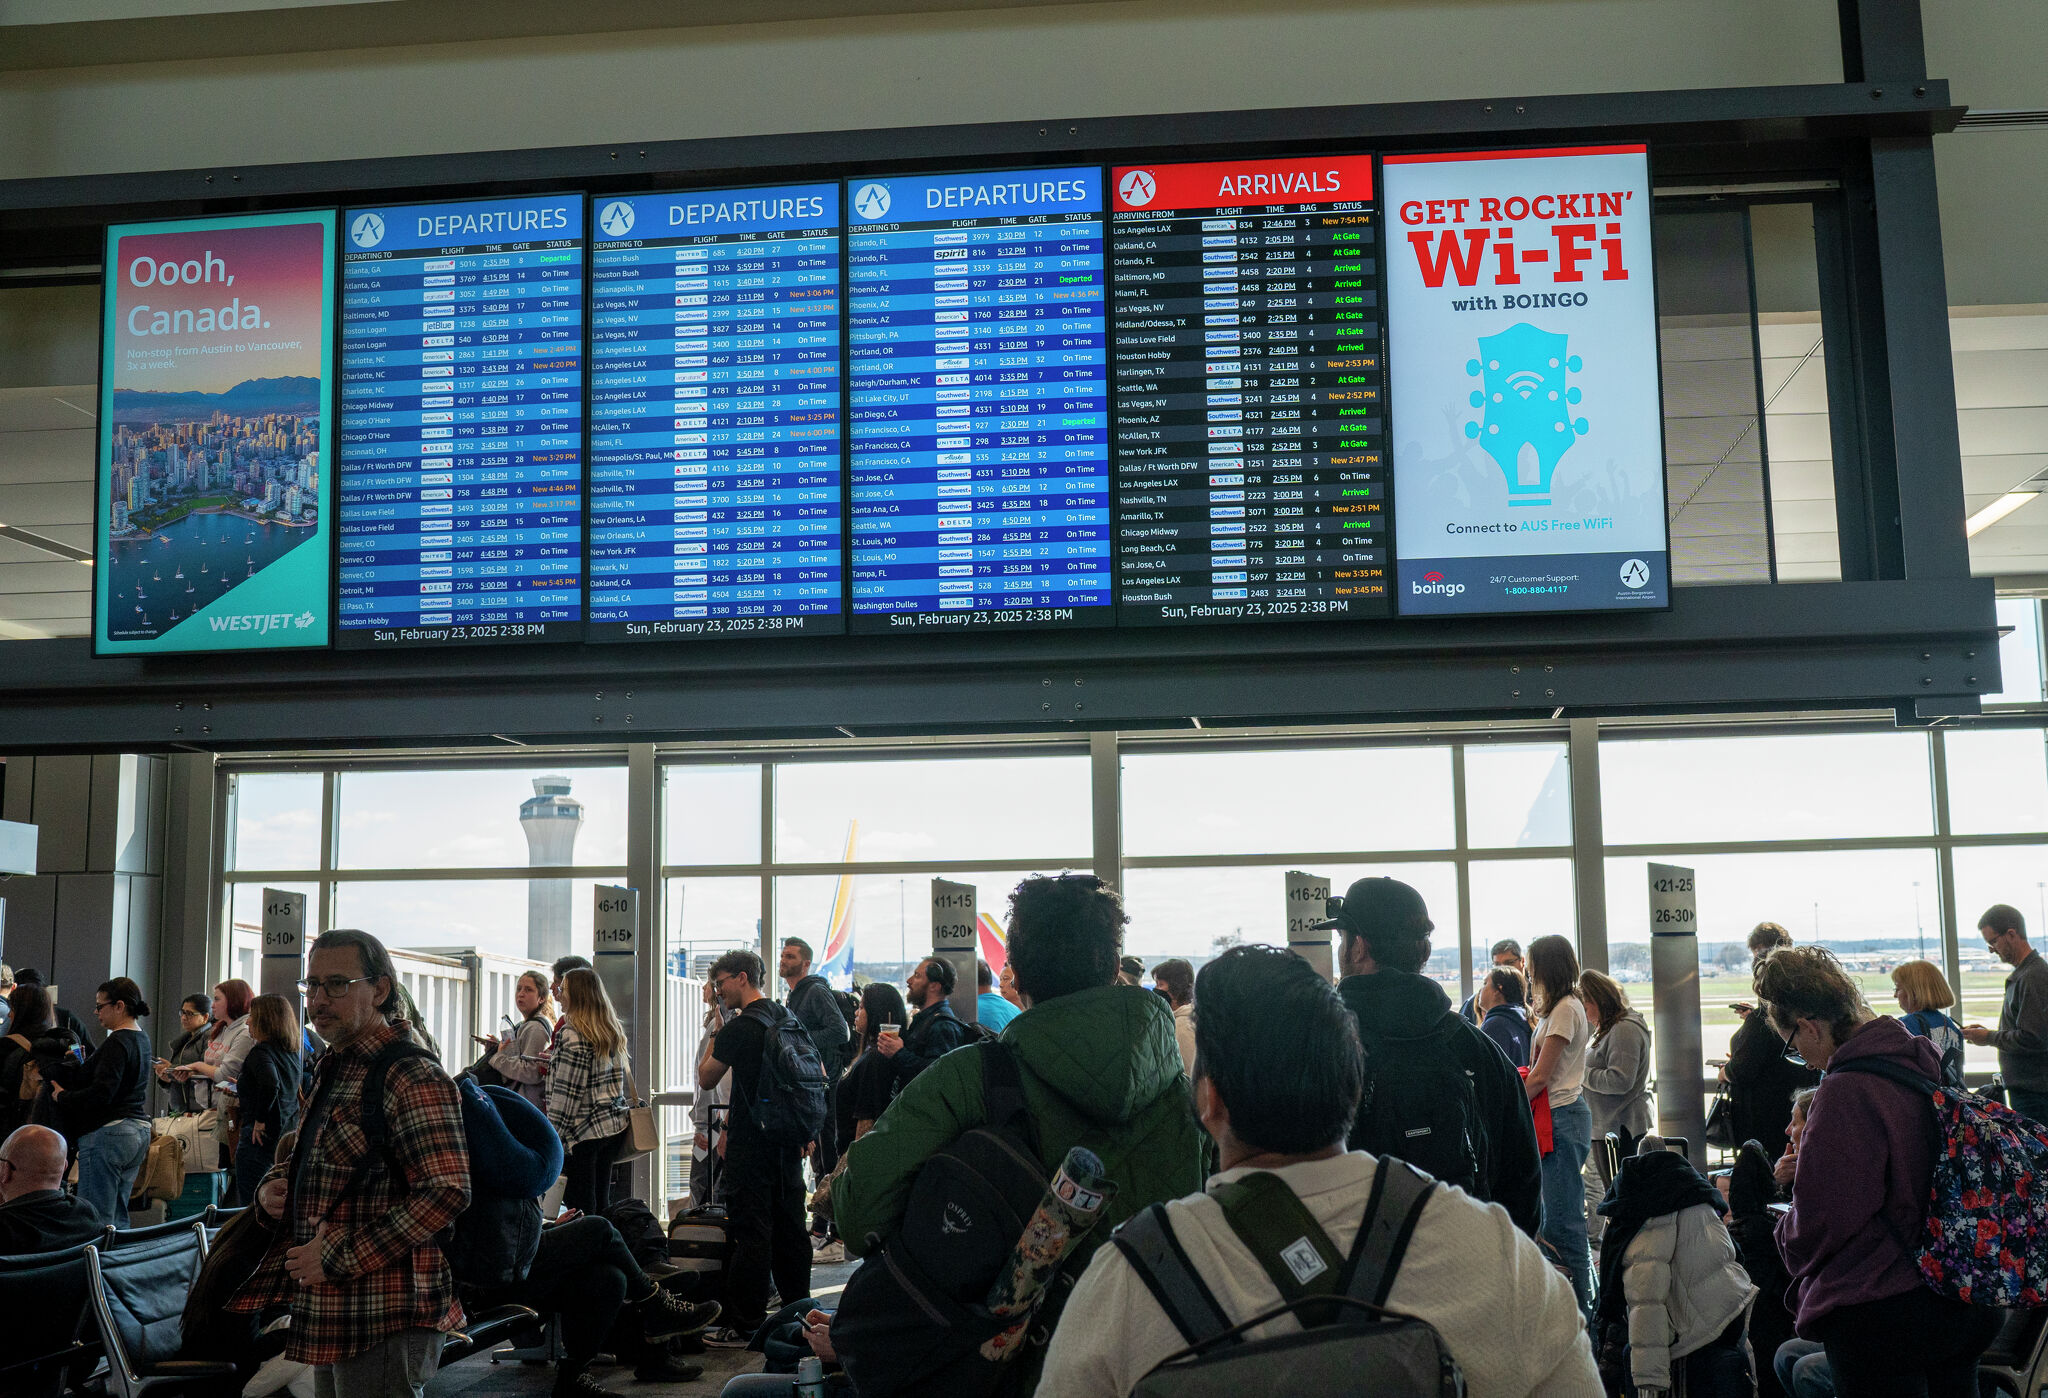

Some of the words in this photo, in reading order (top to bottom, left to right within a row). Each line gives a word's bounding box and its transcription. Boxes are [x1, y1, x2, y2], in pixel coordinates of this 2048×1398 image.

[1218, 170, 1341, 197] ARRIVALS
[926, 180, 1086, 209] DEPARTURES
[669, 196, 824, 226] DEPARTURES
[1113, 212, 1150, 220] ARRIVING
[1333, 202, 1362, 210] STATUS
[1400, 200, 1469, 226] GET
[1480, 191, 1634, 222] ROCKIN'
[418, 208, 567, 237] DEPARTURES
[849, 224, 888, 232] DEPARTING
[1263, 220, 1283, 228] 12:46
[594, 241, 632, 249] DEPARTING
[802, 229, 828, 237] STATUS
[345, 252, 382, 260] DEPARTING
[936, 250, 966, 259] spirit
[998, 248, 1013, 256] 5:12
[1408, 223, 1629, 288] Wi-Fi
[129, 251, 234, 288] Oooh,
[1452, 296, 1498, 312] with
[1502, 292, 1589, 310] BOINGO
[128, 298, 270, 336] Canada.
[128, 350, 172, 360] Non-stop
[175, 346, 198, 355] from
[200, 344, 232, 354] Austin
[235, 344, 245, 352] to
[248, 341, 302, 351] Vancouver,
[1268, 347, 1285, 355] 2:40
[1286, 346, 1298, 354] PM
[127, 362, 138, 370] 3x
[148, 360, 177, 369] week.
[1446, 521, 1501, 534] Connect
[1503, 521, 1517, 532] to
[1520, 519, 1548, 532] AUS
[1551, 519, 1580, 531] Free
[1583, 518, 1614, 529] WiFi
[1121, 545, 1139, 554] Long
[1275, 540, 1291, 548] 3:20
[1292, 539, 1304, 548] PM
[1413, 581, 1465, 596] boingo
[1505, 586, 1568, 594] 1-800-880-4117
[1162, 606, 1187, 618] Sun,
[1190, 605, 1244, 617] February
[1246, 604, 1265, 616] 23,
[1268, 603, 1297, 614] 2025
[1300, 602, 1327, 613] 2:38
[1330, 601, 1348, 612] PM
[209, 613, 294, 635] WESTJET
[890, 615, 915, 627] Sun,
[918, 613, 971, 625] February
[973, 612, 991, 624] 23,
[994, 611, 1022, 622] 2025
[1025, 610, 1051, 621] 2:38
[1054, 609, 1073, 620] PM
[374, 630, 398, 642] Sun,
[400, 629, 449, 640] February
[452, 628, 468, 639] 23,
[471, 626, 498, 637] 2025
[500, 625, 525, 636] 2:38
[527, 624, 544, 635] PM
[626, 623, 651, 635] Sun,
[654, 622, 704, 634] February
[707, 620, 724, 632] 23,
[727, 620, 754, 631] 2025
[758, 618, 783, 629] 2:38
[785, 617, 804, 628] PM
[1660, 879, 1692, 892] 21-25
[940, 895, 971, 907] 11-15
[1296, 888, 1328, 901] 16-20
[273, 904, 290, 915] 1-5
[604, 900, 627, 912] 6-10
[1656, 909, 1688, 922] 26-30
[266, 932, 289, 944] 6-10
[596, 929, 626, 942] 11-15
[935, 925, 966, 938] 16-20
